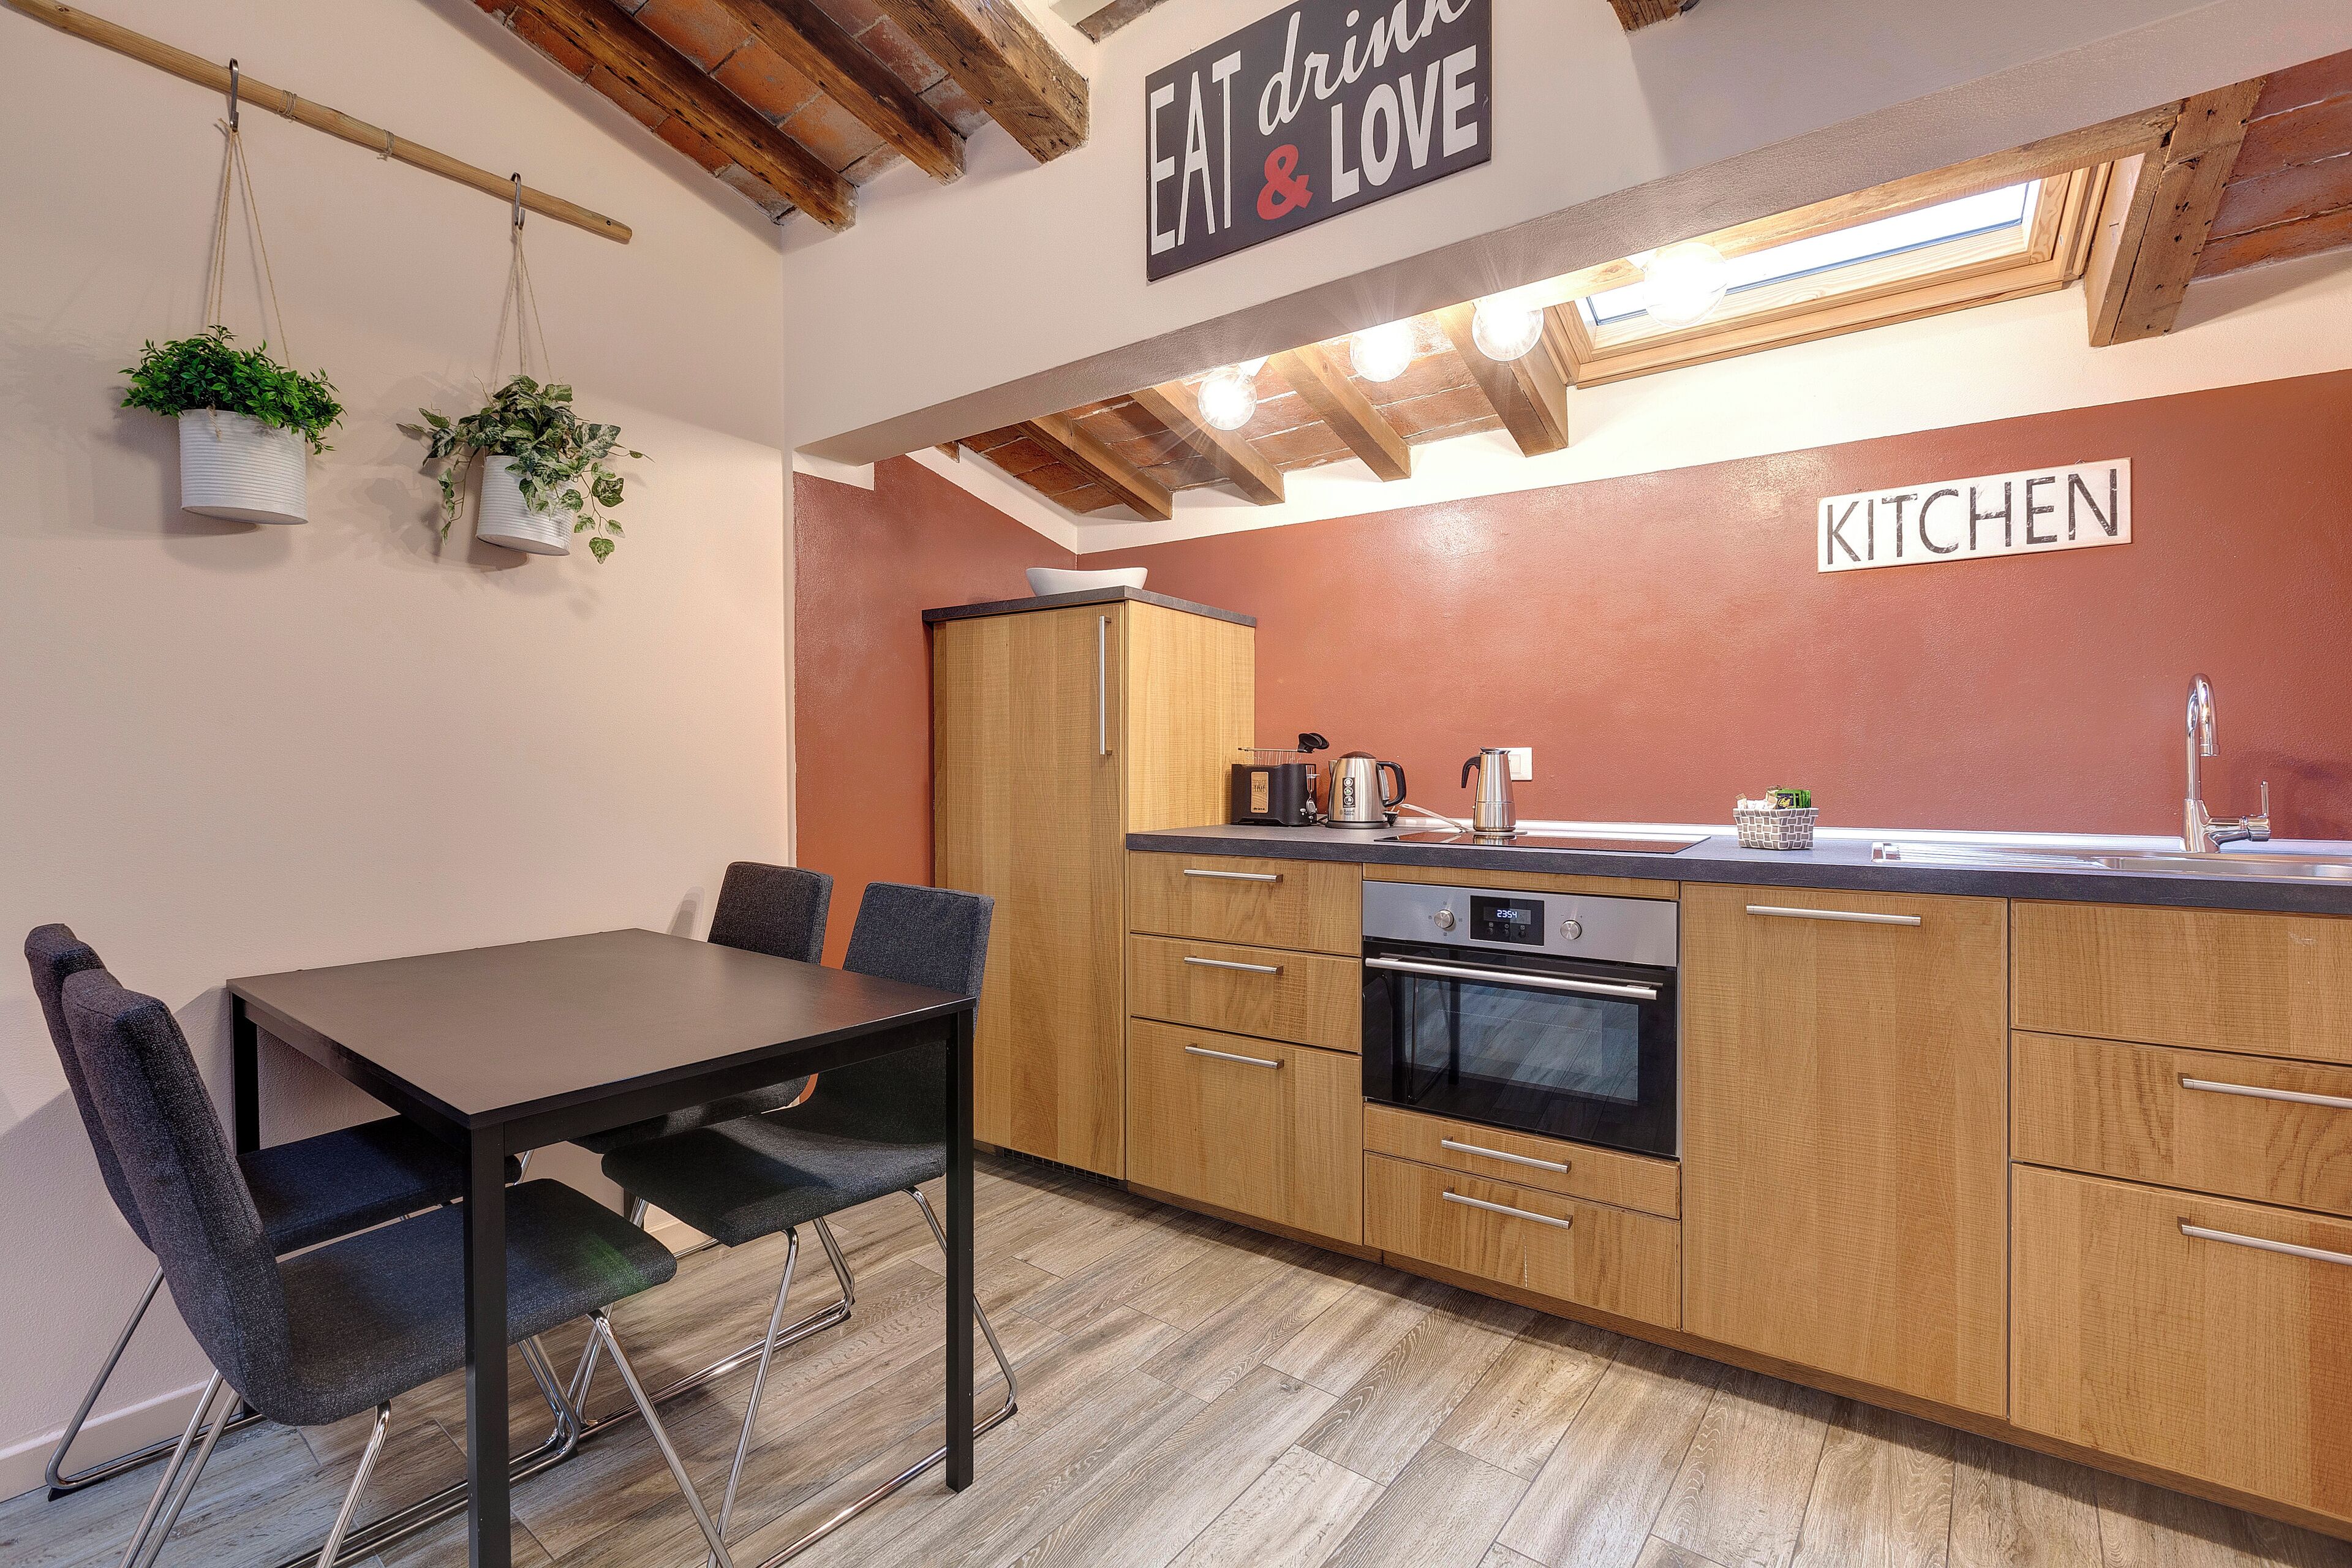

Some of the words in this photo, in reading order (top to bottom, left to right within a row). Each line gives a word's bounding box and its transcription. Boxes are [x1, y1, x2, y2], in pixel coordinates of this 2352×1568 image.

[1150, 50, 1242, 256] EAT
[1256, 143, 1314, 221] &
[1330, 44, 1478, 203] LOVE
[1826, 468, 2118, 565] KITCHEN
